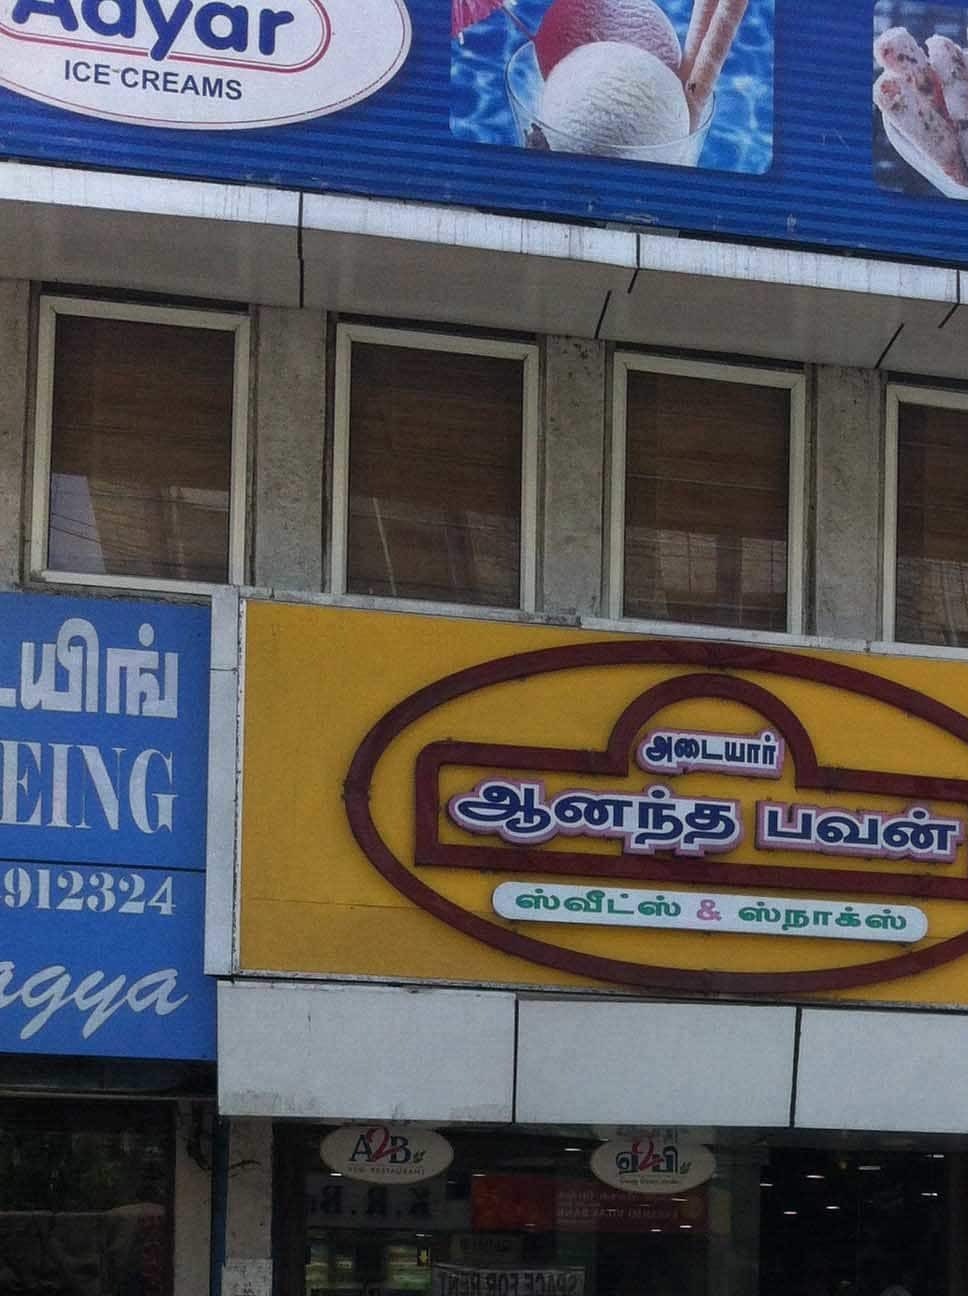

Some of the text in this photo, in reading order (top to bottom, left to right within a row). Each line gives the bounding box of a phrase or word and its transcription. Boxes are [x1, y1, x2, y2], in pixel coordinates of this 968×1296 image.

[64, 59, 243, 100] ICE CREAMS
[646, 734, 776, 766] அடையார்
[0, 740, 178, 834] EING
[457, 785, 957, 851] ஆனந்த பவன்
[4, 867, 176, 915] 912324
[515, 888, 907, 931] ஸ்வீட்ஸ் & ஸ்நாக்ஸ்
[348, 1125, 411, 1163] A2B
